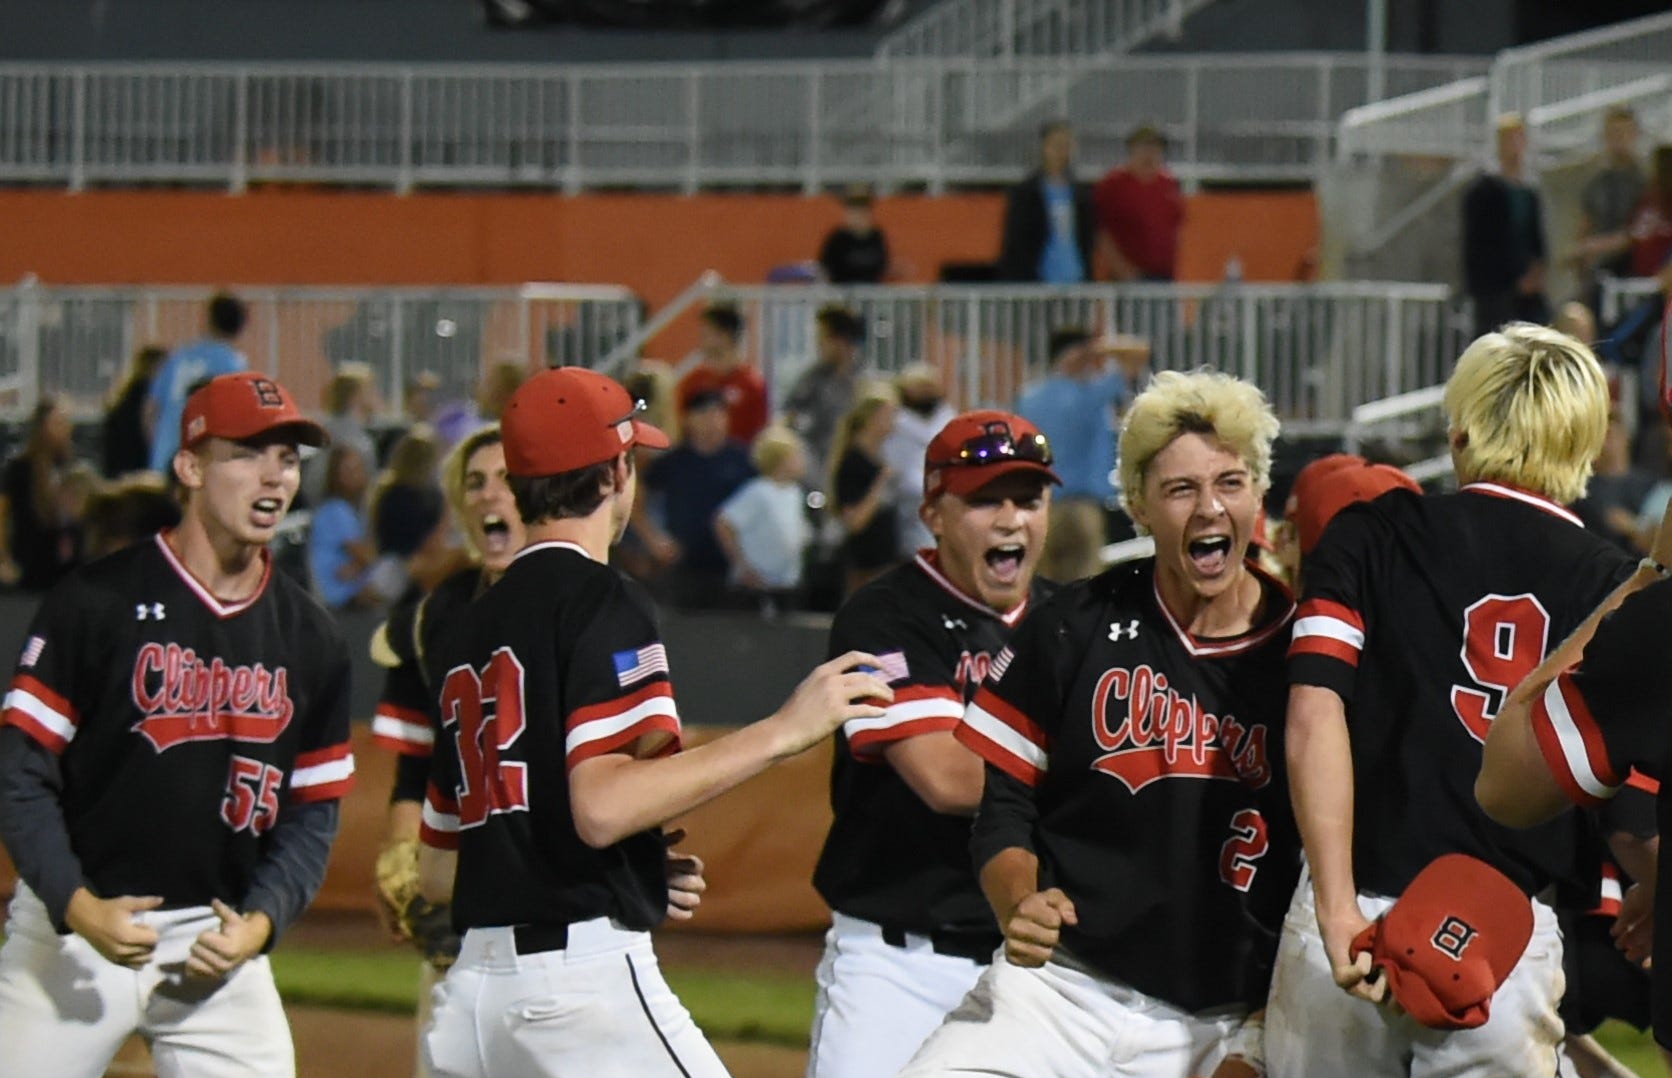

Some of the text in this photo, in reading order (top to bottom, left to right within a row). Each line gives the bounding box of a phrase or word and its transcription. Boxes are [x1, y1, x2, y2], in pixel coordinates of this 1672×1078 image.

[251, 378, 284, 408] B
[133, 642, 294, 730] Clippers
[1451, 592, 1551, 745] 9
[439, 646, 530, 831] 32
[1092, 664, 1272, 790] Clipprs
[219, 754, 284, 837] 55
[1219, 808, 1269, 892] 2
[1430, 914, 1479, 961] B
